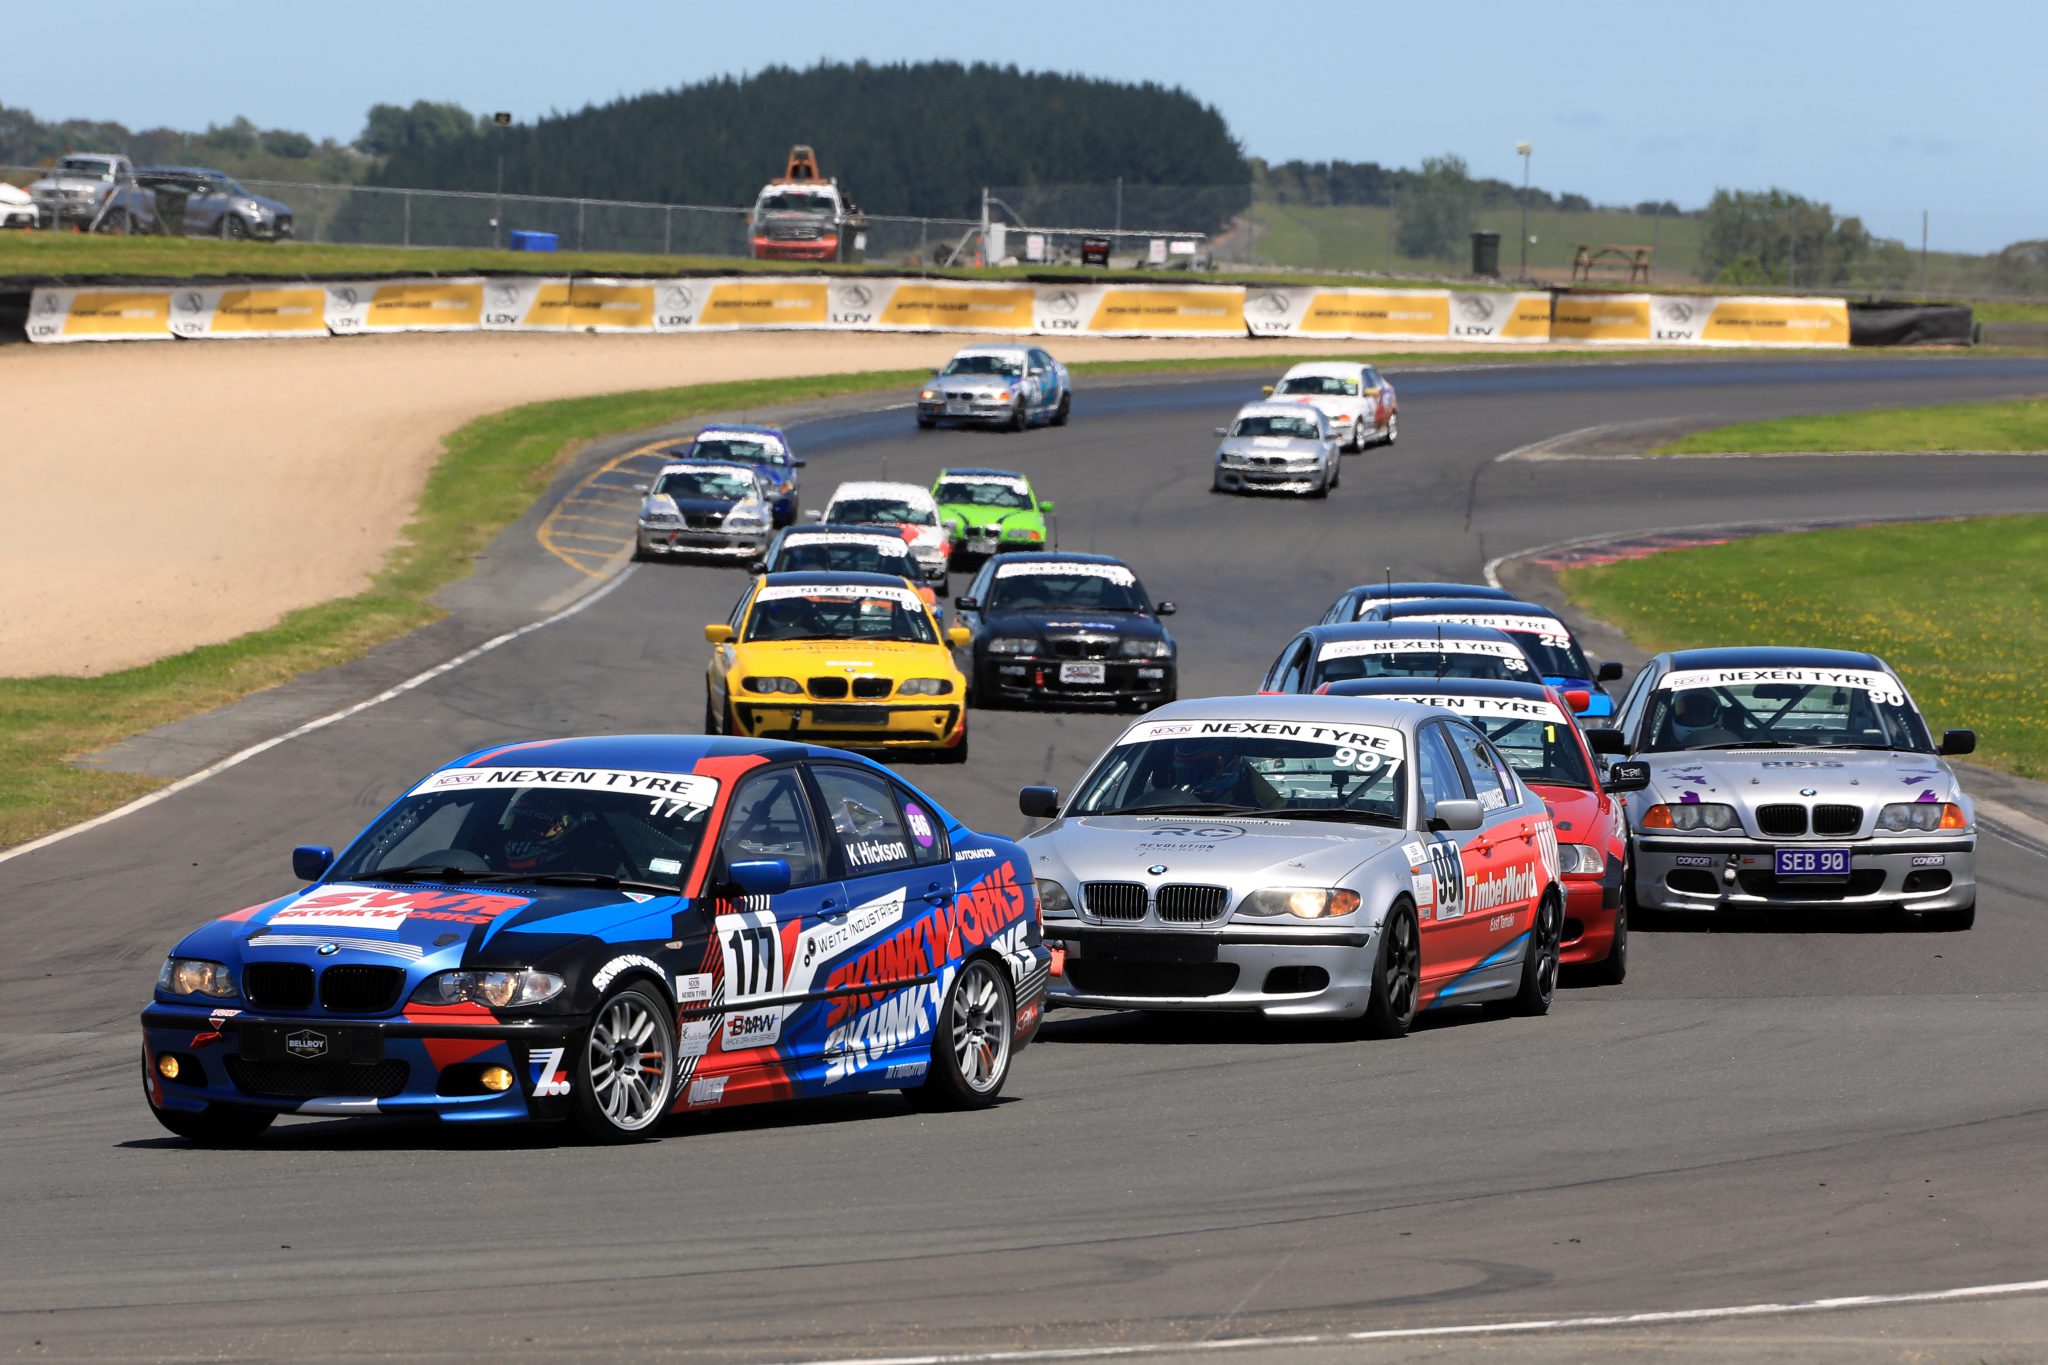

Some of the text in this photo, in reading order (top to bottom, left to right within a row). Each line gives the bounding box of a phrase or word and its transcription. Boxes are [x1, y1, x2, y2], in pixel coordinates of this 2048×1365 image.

[659, 314, 692, 325] LDV
[832, 312, 872, 323] LDV
[1041, 318, 1080, 329] LDV
[1253, 321, 1292, 331] LDV
[1454, 325, 1494, 336] LDV
[1656, 330, 1693, 340] LDV
[800, 586, 856, 594] NEXEN
[1504, 618, 1551, 630] TYRE
[1374, 641, 1444, 650] NEXEN
[1454, 642, 1507, 654] TYRE
[1539, 633, 1571, 649] 25
[1503, 658, 1529, 672] 58
[1719, 670, 1876, 687] NEXEN TYRE
[1868, 688, 1904, 707] 90
[1473, 699, 1548, 716] TYRE
[1201, 723, 1390, 750] NEXEN TYRE
[1544, 725, 1556, 744] 1
[1332, 748, 1404, 779] 991
[486, 770, 694, 795] NEXEN TYRE
[649, 797, 709, 821] 177
[908, 814, 931, 836] E46
[846, 840, 908, 866] K Hickson
[955, 848, 996, 861] AUTONATION
[1677, 857, 1711, 866] CONDOR
[1781, 852, 1844, 871] SEB 90
[1913, 856, 1944, 866] CONDOR
[1432, 844, 1464, 905] 991
[1466, 861, 1538, 912] TimberWorld
[272, 907, 496, 925] SKUNKWORKS
[818, 899, 900, 953] WEITZ INDUSTRIES
[826, 860, 1024, 1028] SKUNKWORKS
[728, 926, 775, 997] 177
[733, 1013, 775, 1036] BMW
[289, 1040, 324, 1048] BELLROY
